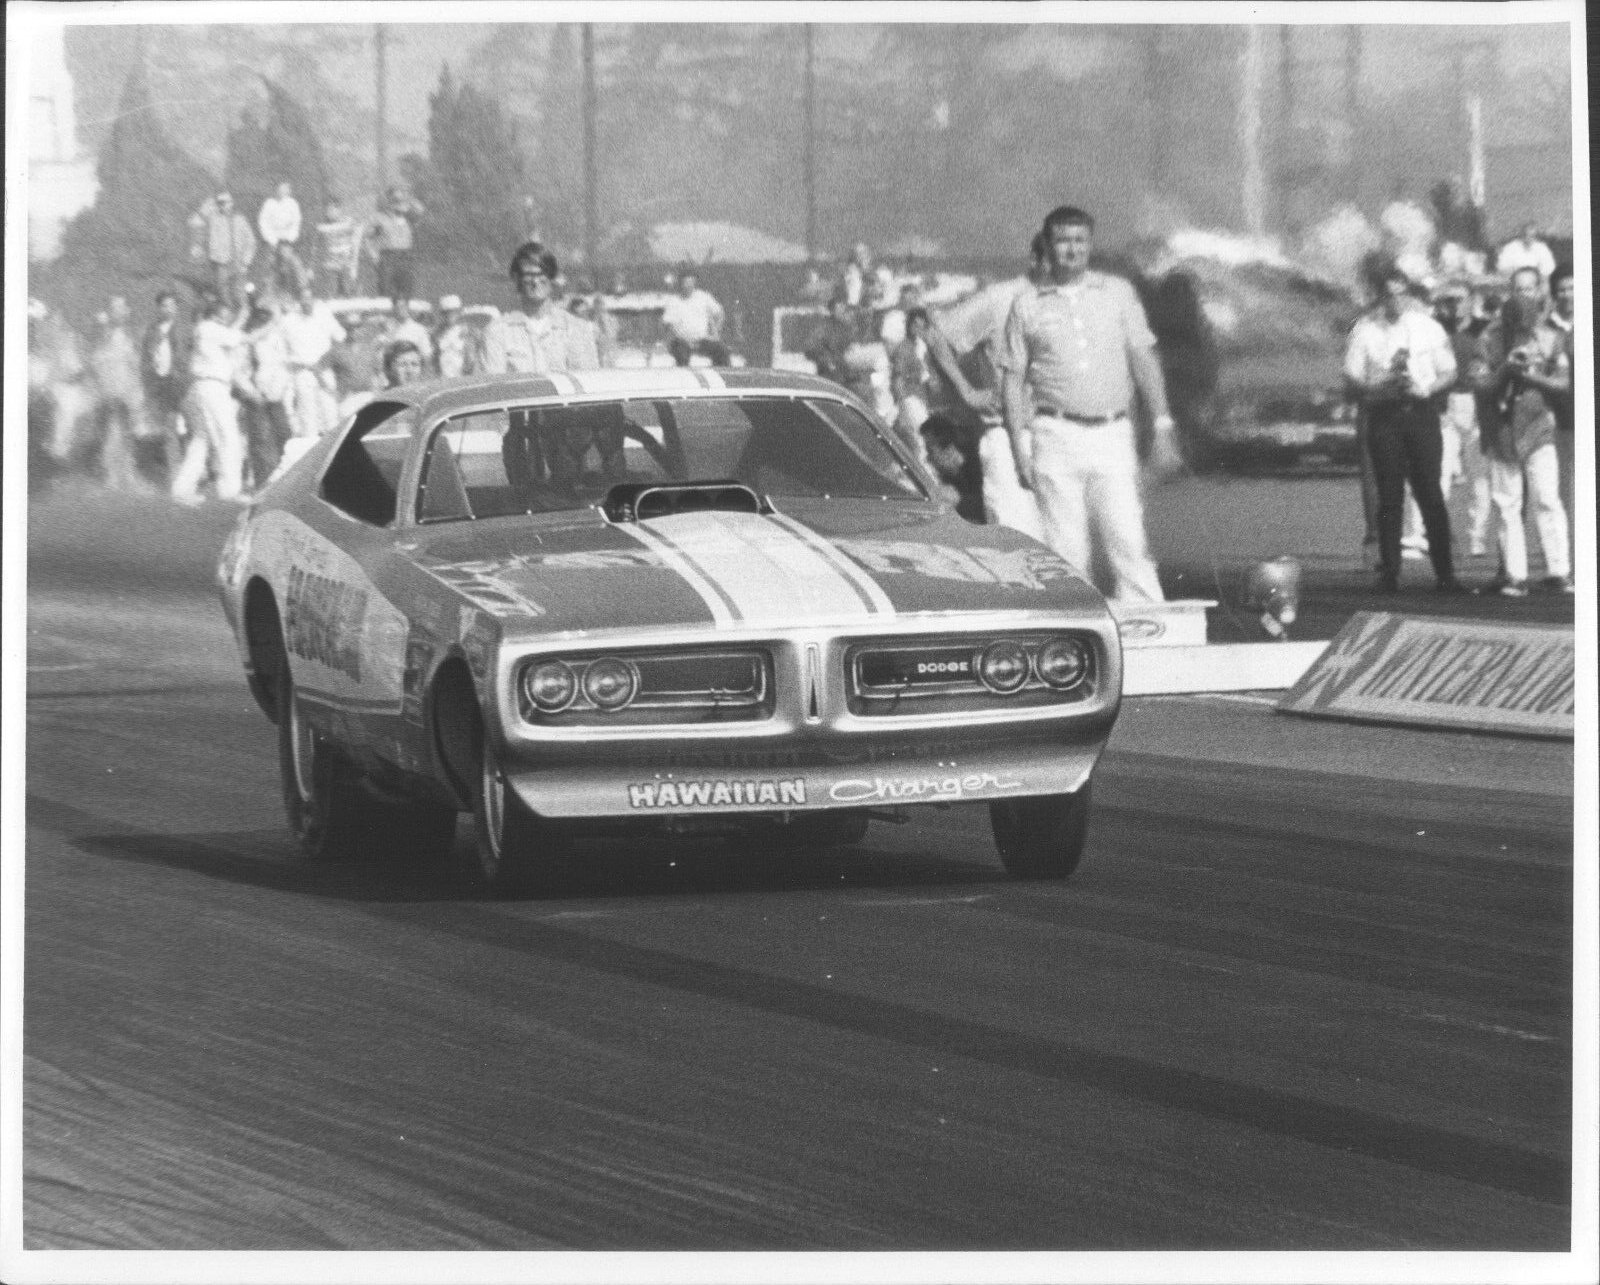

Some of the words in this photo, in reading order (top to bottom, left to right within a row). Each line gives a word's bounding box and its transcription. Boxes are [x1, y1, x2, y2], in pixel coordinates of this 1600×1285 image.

[917, 661, 969, 674] DODGE
[1358, 634, 1574, 715] WINTERNATIO
[628, 778, 806, 808] HAWAIIAN
[829, 772, 1023, 801] Charger
